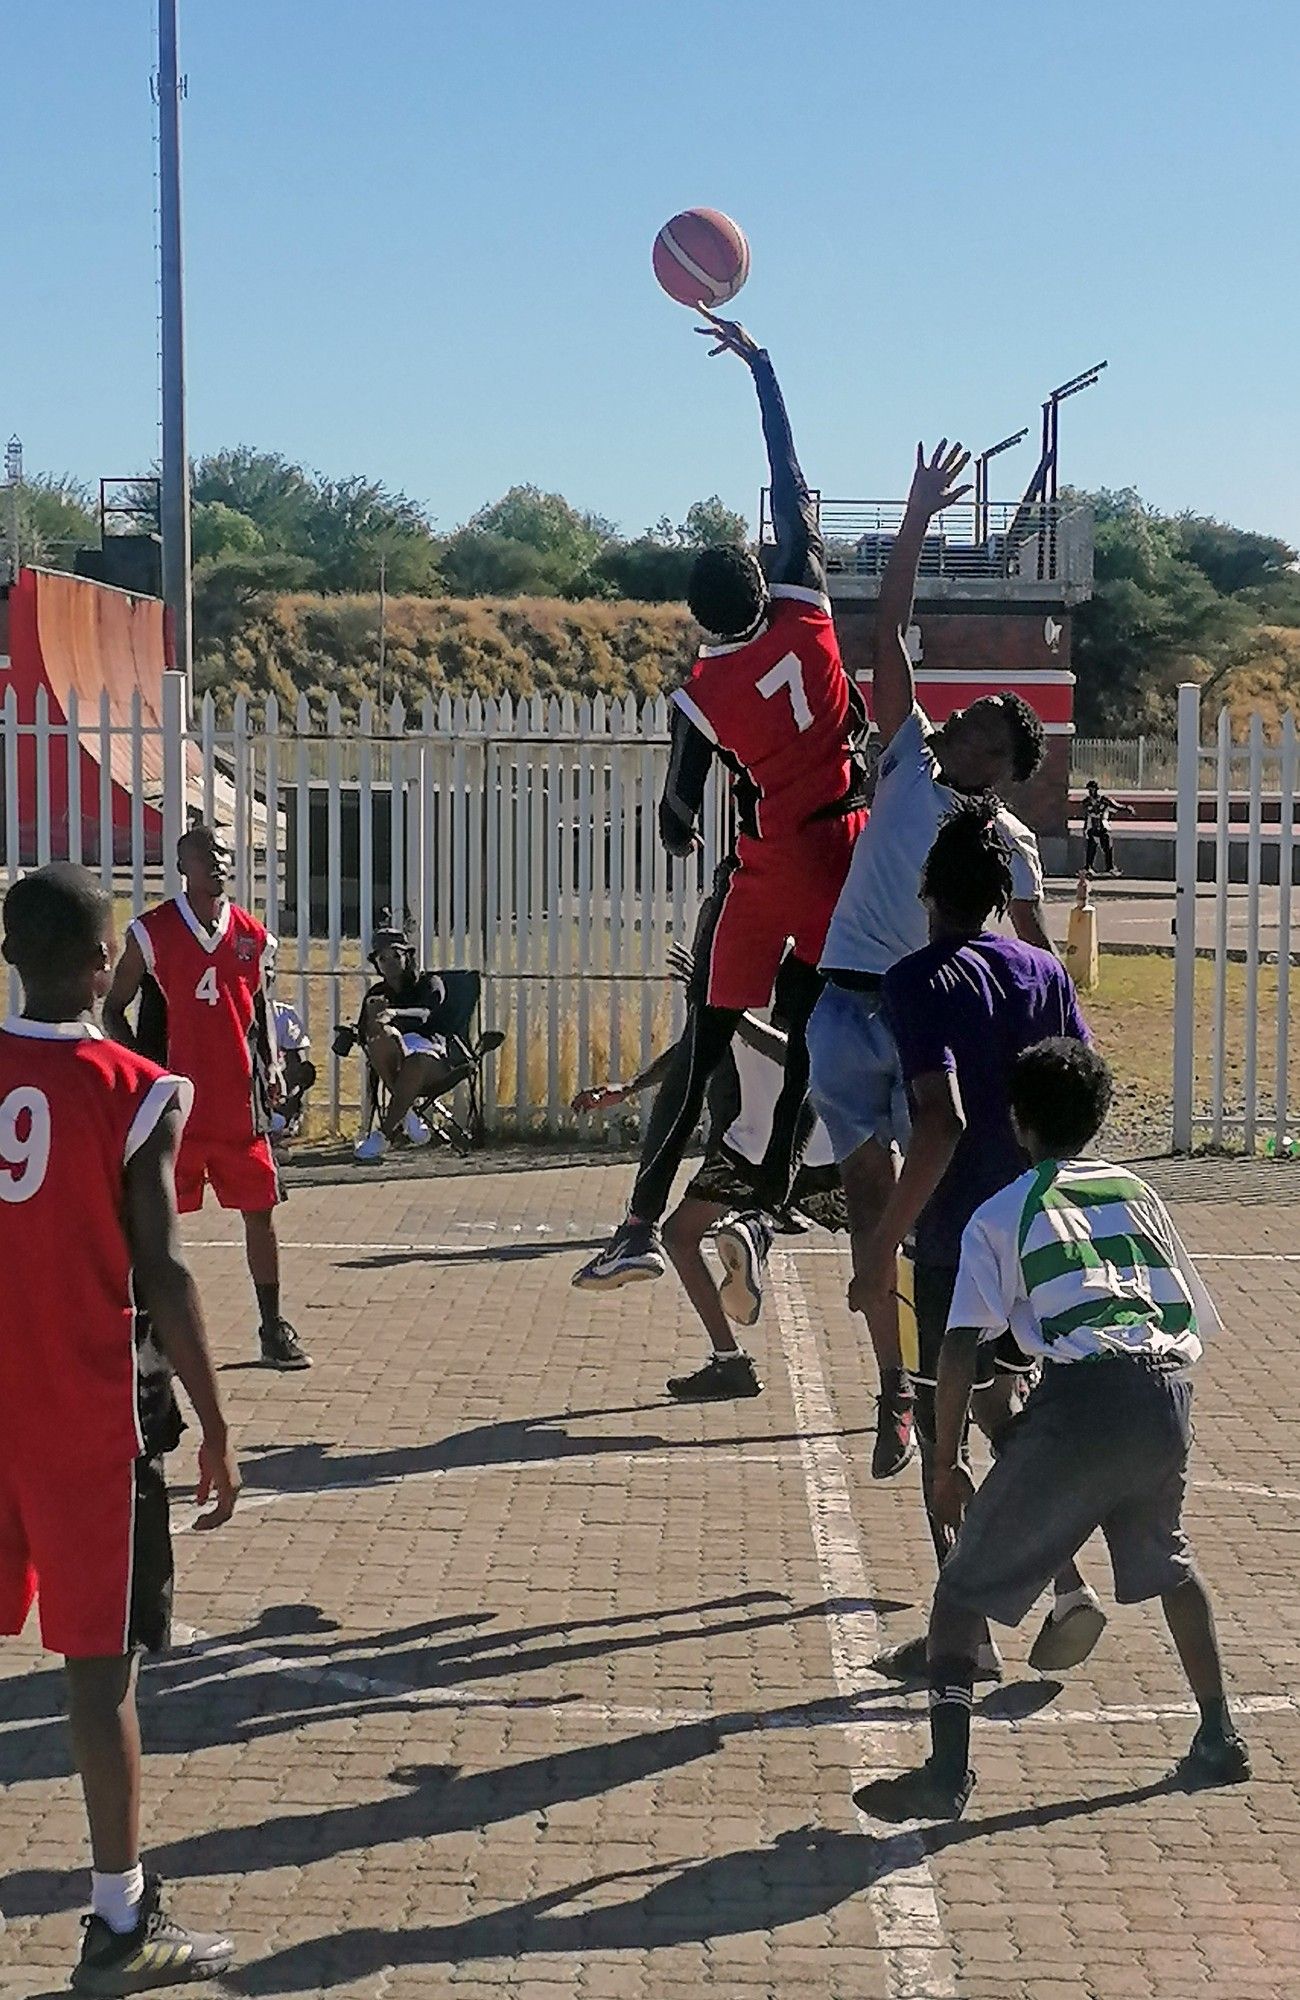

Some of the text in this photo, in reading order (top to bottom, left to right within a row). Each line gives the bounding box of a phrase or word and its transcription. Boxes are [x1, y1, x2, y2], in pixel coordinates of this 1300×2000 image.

[755, 650, 814, 733] 7
[195, 966, 220, 1006] 4
[0, 1086, 51, 1202] 9
